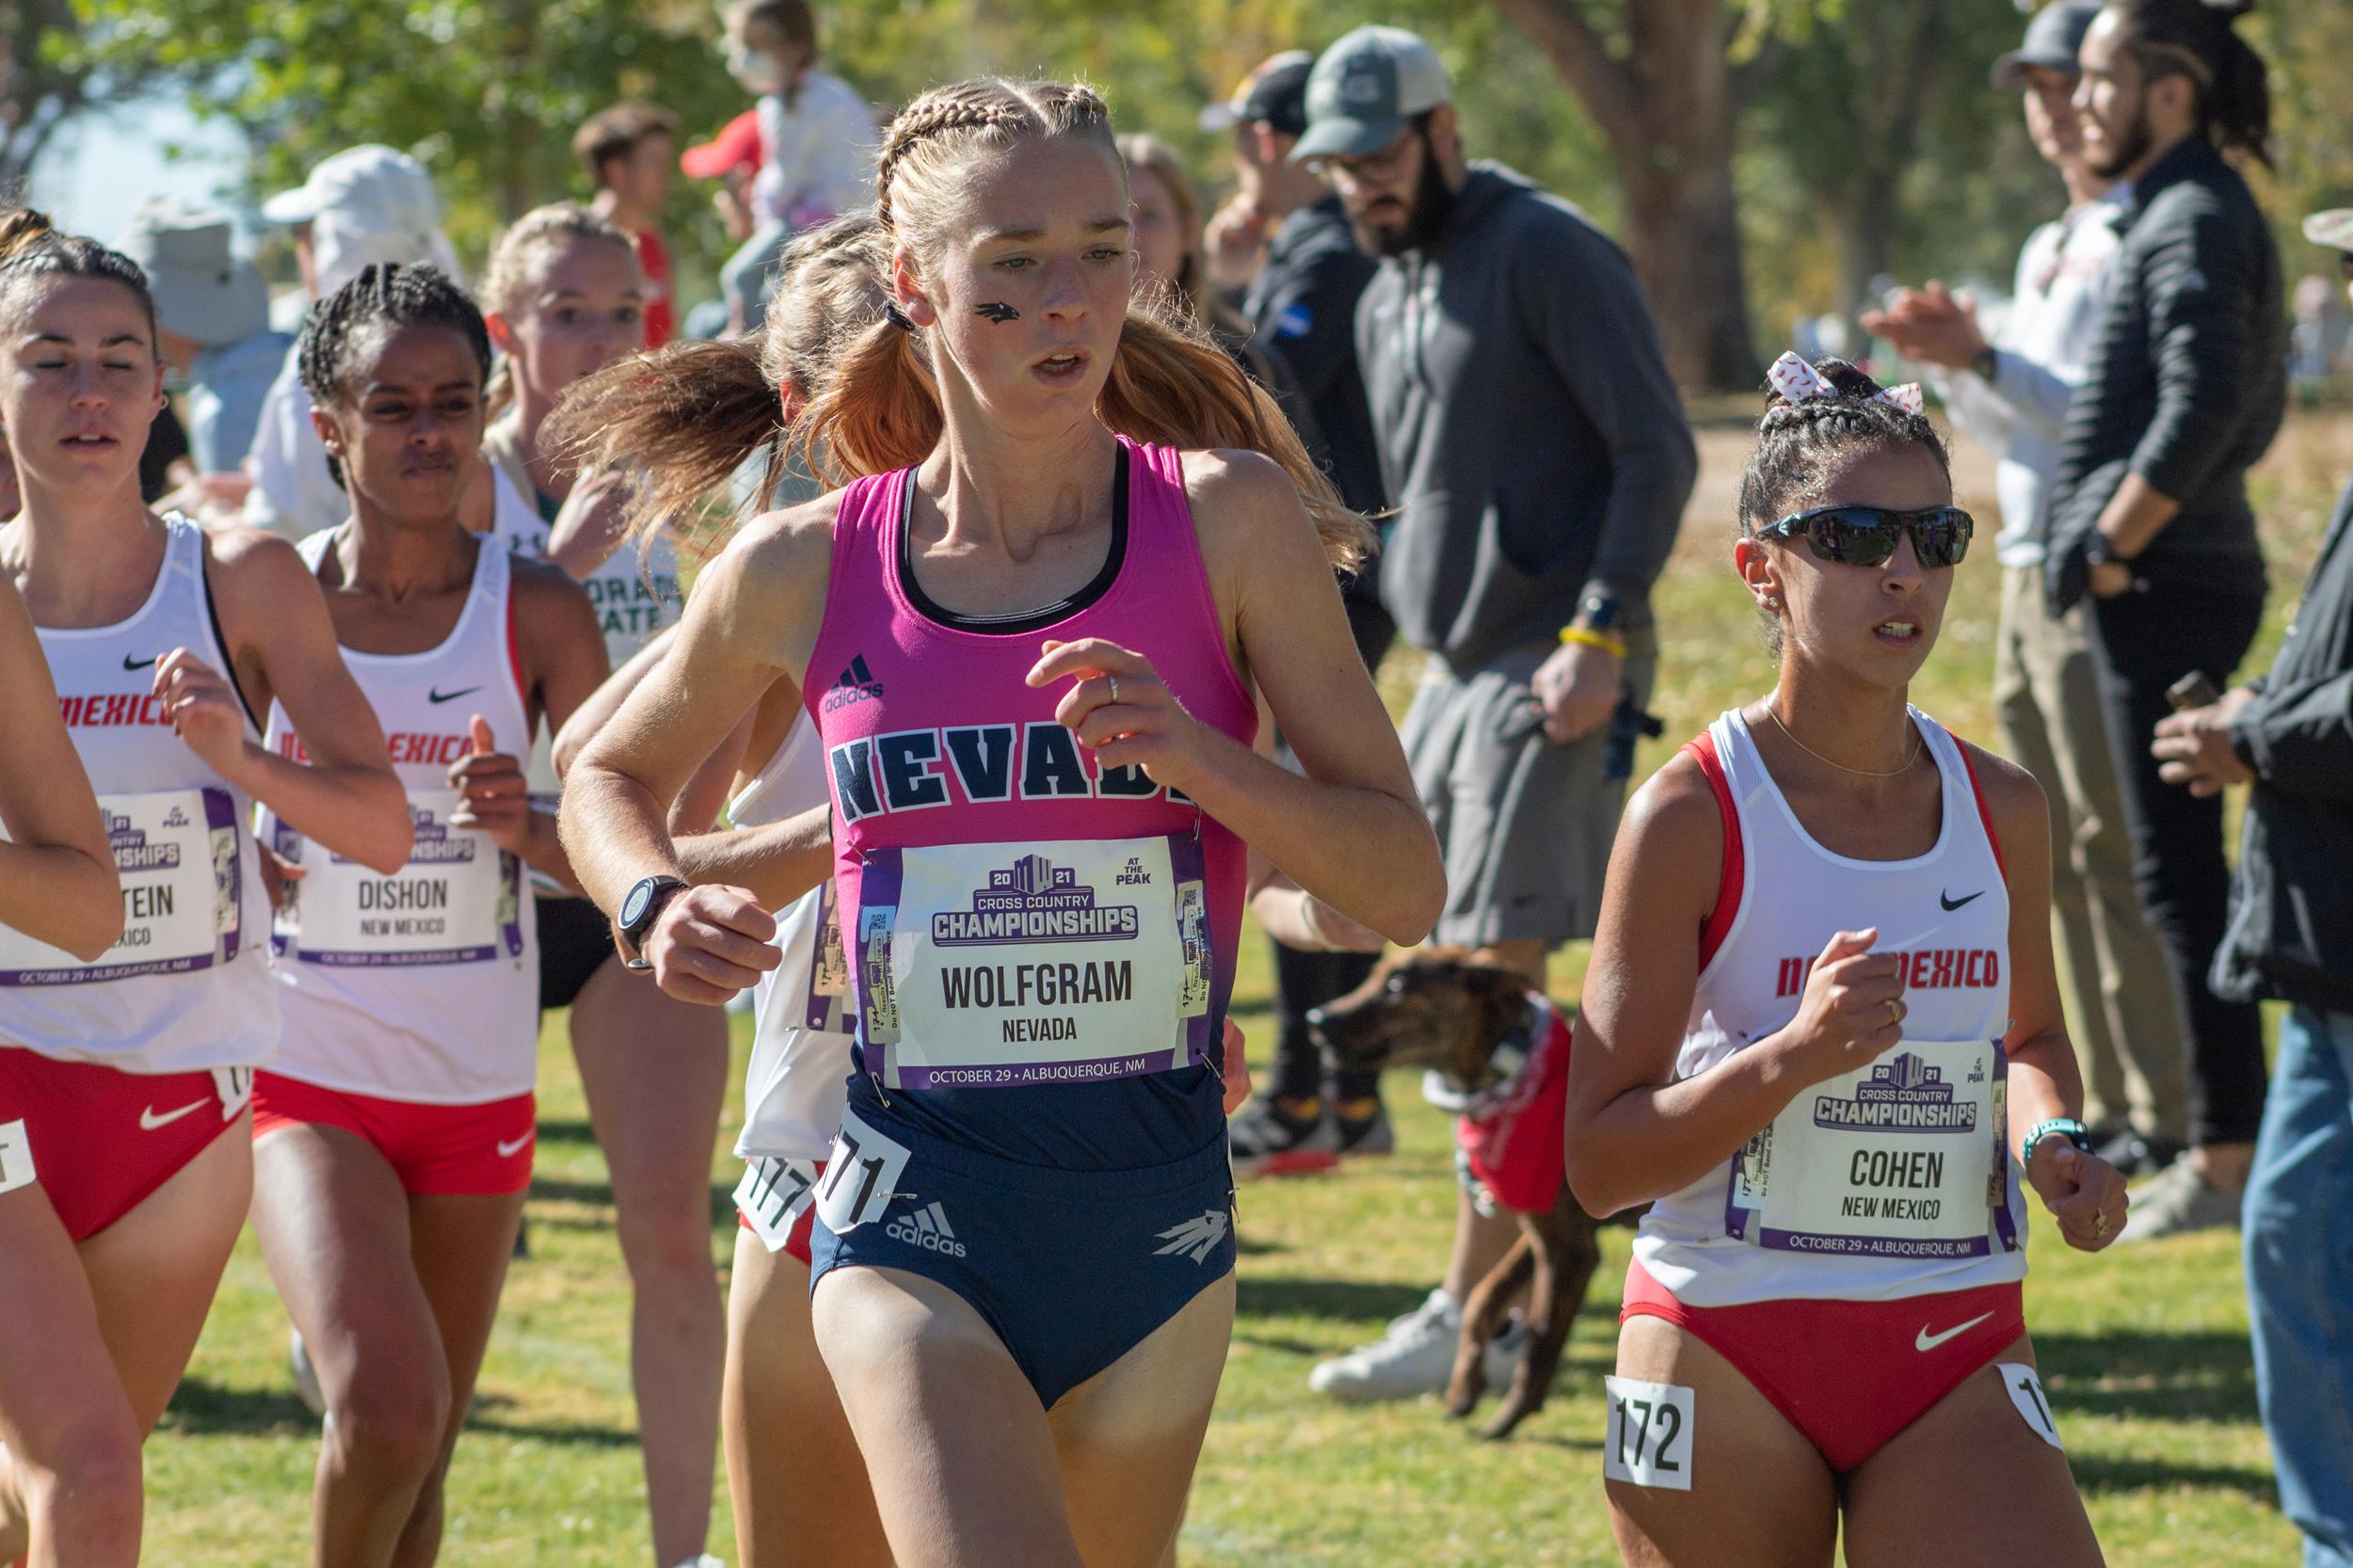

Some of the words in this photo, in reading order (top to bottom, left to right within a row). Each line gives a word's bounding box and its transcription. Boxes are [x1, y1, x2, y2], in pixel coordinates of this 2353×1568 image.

[825, 683, 884, 712] adidas
[388, 732, 472, 765] EXIC
[829, 721, 1200, 827] NEVAD
[163, 818, 190, 828] PEAK
[111, 835, 142, 847] NTRY
[114, 843, 178, 867] NSHIPS
[1128, 857, 1140, 866] AT
[993, 872, 1011, 886] 20
[1056, 872, 1070, 884] 21
[1116, 873, 1151, 886] PEAK
[359, 879, 447, 910] DISHON
[978, 897, 1023, 910] CROSS
[1026, 895, 1090, 908] COUNTRY
[360, 919, 390, 936] NEW
[394, 918, 445, 935] MEXICO
[934, 908, 1137, 939] CHAMPIONSHIPS
[940, 960, 1131, 1009] WOLFGRAM
[1199, 991, 1206, 1001] Do
[891, 1017, 898, 1028] Do
[1002, 1016, 1078, 1043] NEVADA
[929, 1070, 992, 1083] OCTOBER
[996, 1069, 1012, 1081] 29
[1022, 1063, 1123, 1080] ALBUQUERQUE,
[1126, 1058, 1145, 1072] NM
[1875, 1067, 1890, 1079] 20
[1926, 1068, 1937, 1080] 21
[1967, 1072, 1984, 1083] PEAK
[1860, 1090, 1896, 1101] CROSS
[1898, 1090, 1949, 1102] COUNTRY
[1817, 1098, 1976, 1127] CHAMPIONSHIPS
[1849, 1149, 1944, 1189] COHEN
[1842, 1196, 1879, 1217] NEW
[1881, 1198, 1941, 1220] MEXICO
[886, 1224, 967, 1257] adidas
[1789, 1236, 1845, 1251] OCTOBER
[1848, 1239, 1863, 1251] 29
[1870, 1240, 1954, 1256] ALBUQUERQUE,
[1956, 1241, 1971, 1254] NM
[1616, 1397, 1681, 1472] 172
